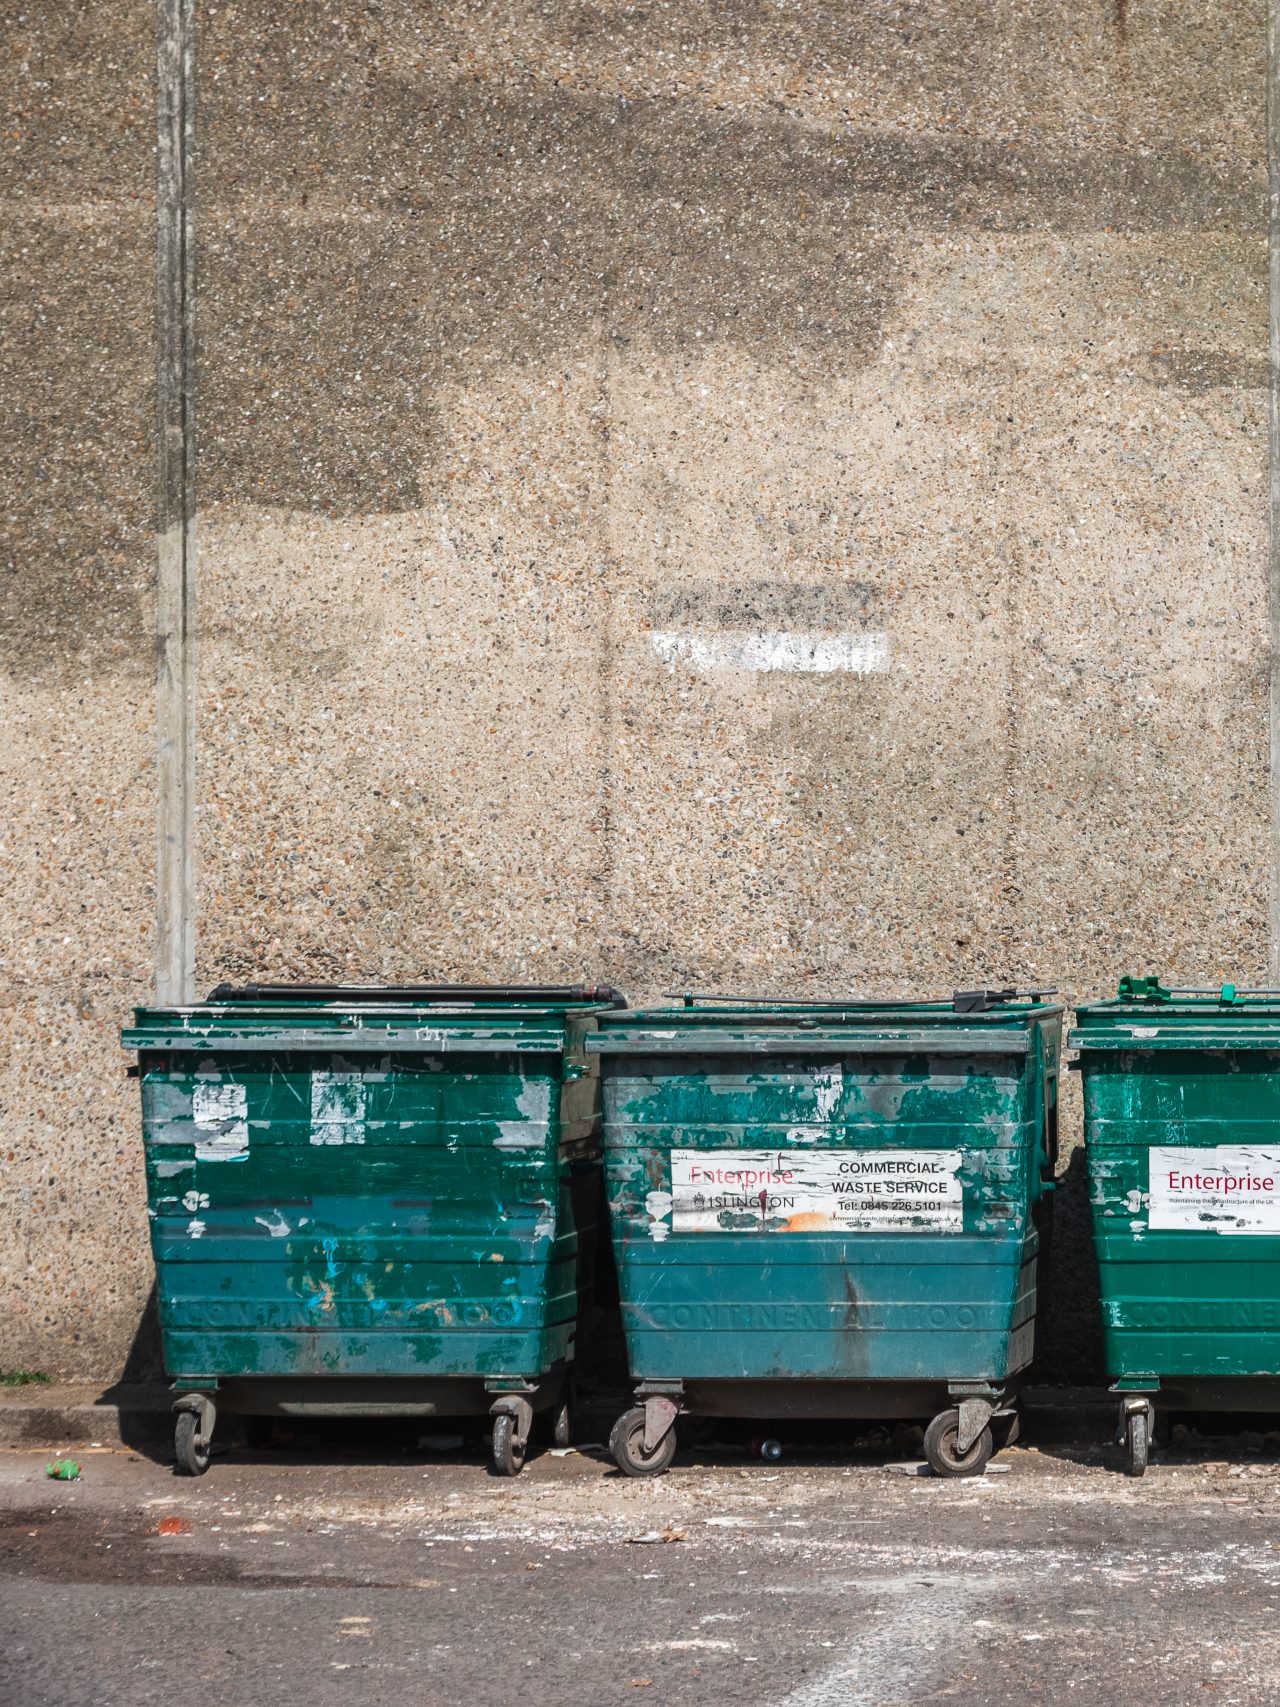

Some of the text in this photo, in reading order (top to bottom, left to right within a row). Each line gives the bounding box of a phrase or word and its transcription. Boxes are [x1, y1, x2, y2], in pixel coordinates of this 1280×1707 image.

[839, 1162, 940, 1174] COMMERCIAL
[691, 1166, 794, 1188] Enterprise
[1169, 1171, 1274, 1194] Enterprise
[831, 1182, 948, 1193] WASTE SERVICE
[838, 1201, 941, 1211] Tel: 0845 226 5101
